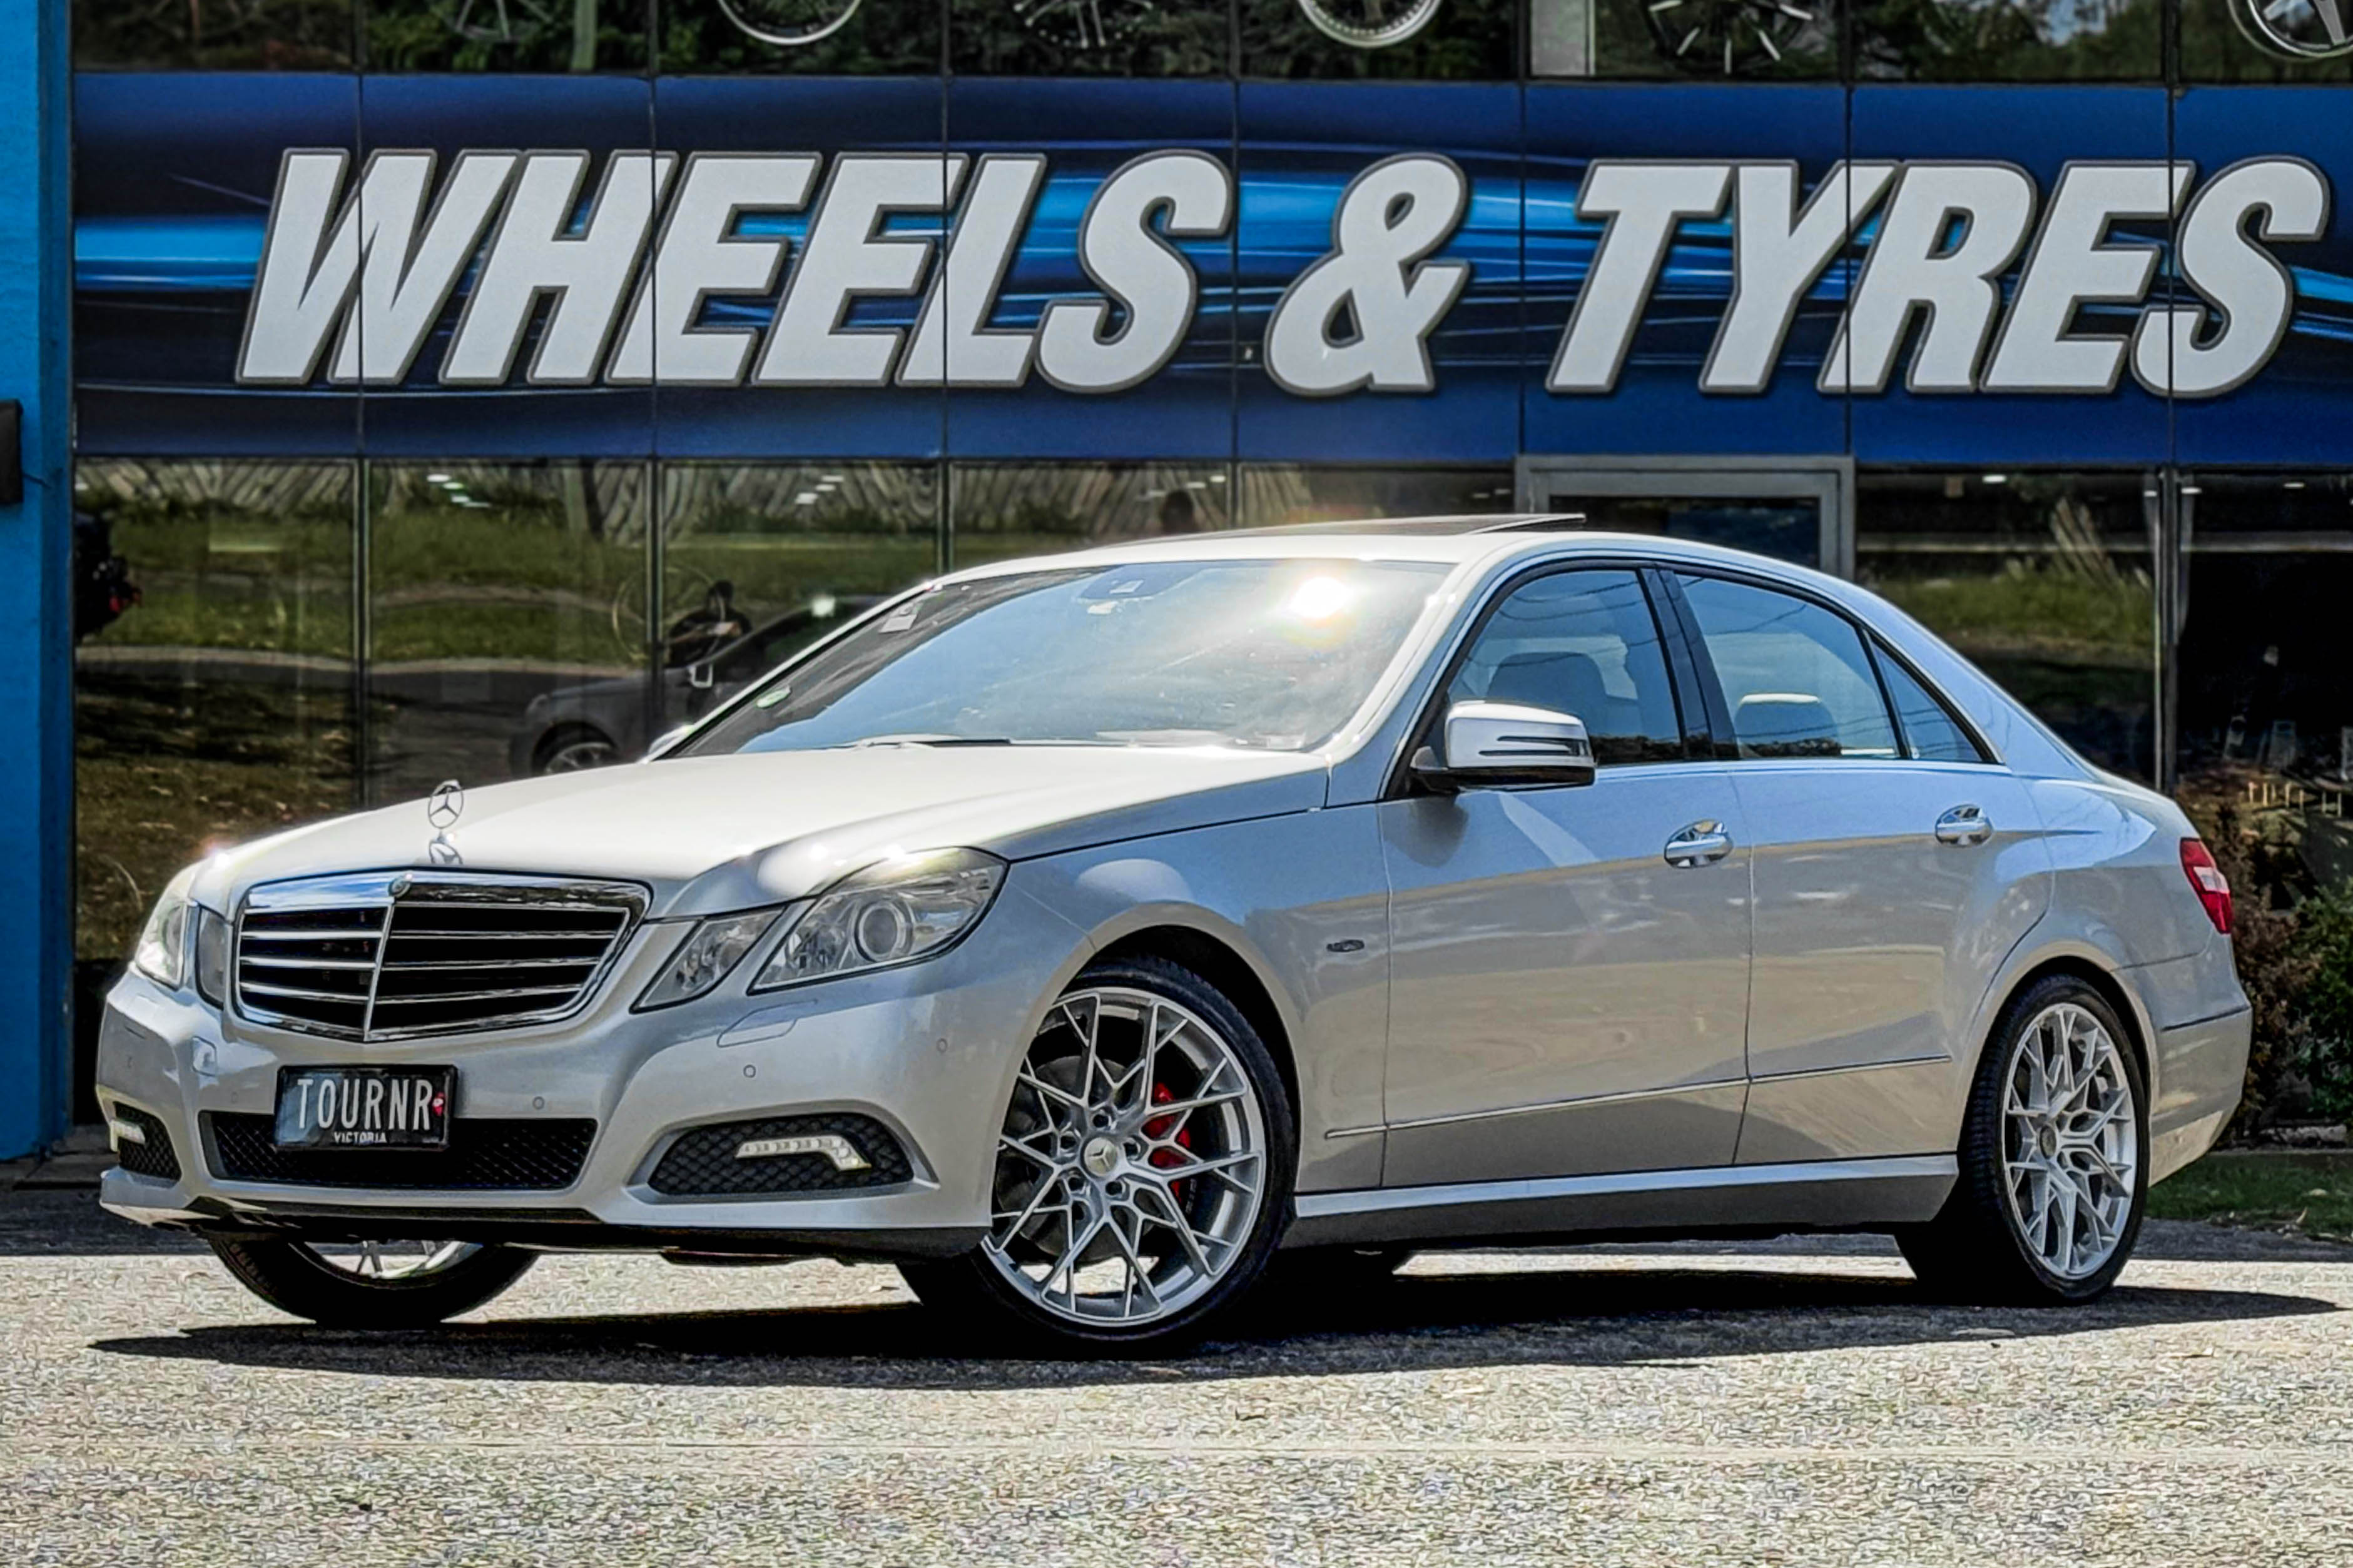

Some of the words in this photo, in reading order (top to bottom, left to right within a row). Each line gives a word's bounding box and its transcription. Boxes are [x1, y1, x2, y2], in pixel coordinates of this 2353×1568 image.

[236, 148, 1234, 393] WHEELS
[1264, 152, 1470, 397] &
[1545, 154, 2330, 399] TYRES
[297, 1078, 433, 1131] TOURNR
[334, 1131, 387, 1144] VICTORIA
